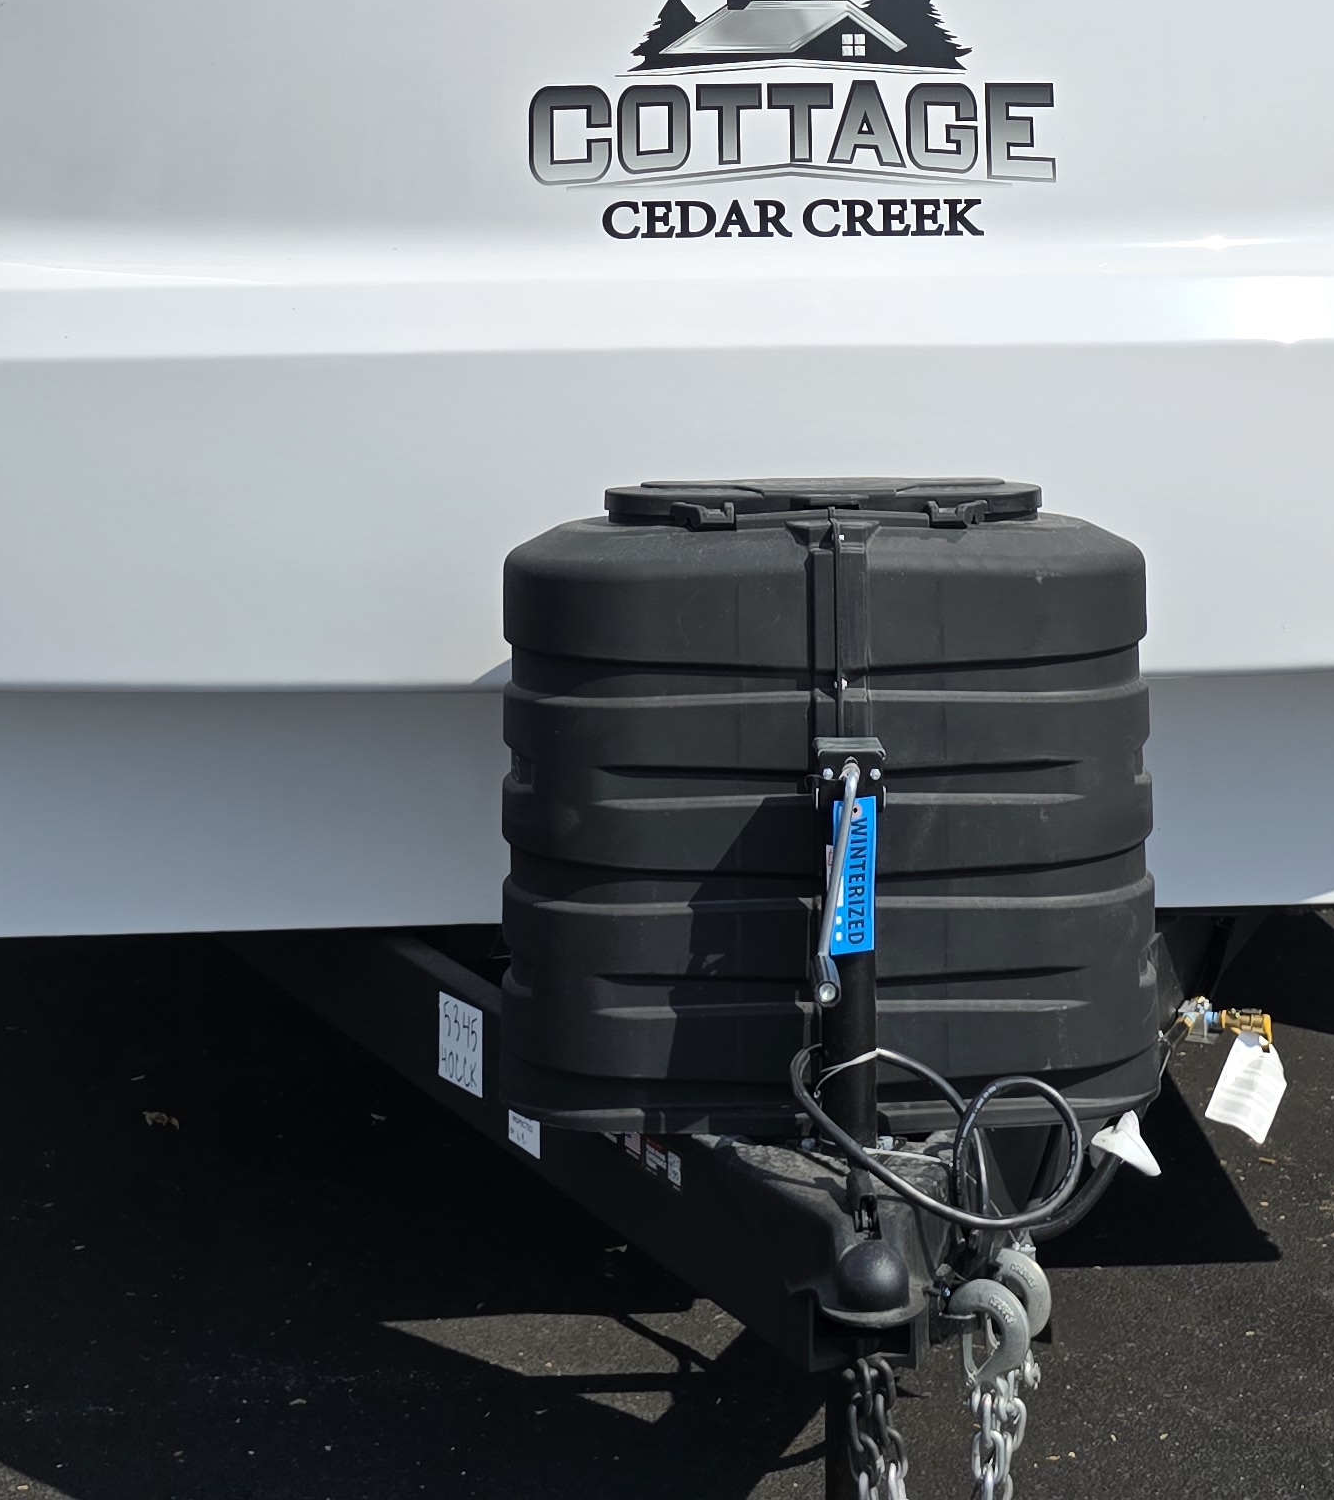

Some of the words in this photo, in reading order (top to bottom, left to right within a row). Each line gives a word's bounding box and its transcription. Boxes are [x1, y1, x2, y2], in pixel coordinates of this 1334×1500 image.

[529, 80, 1057, 186] COTTAGE
[602, 199, 792, 239] CEDAR
[803, 198, 984, 238] CREEK
[847, 817, 868, 945] WINTERIZED
[443, 1000, 478, 1053] 5345
